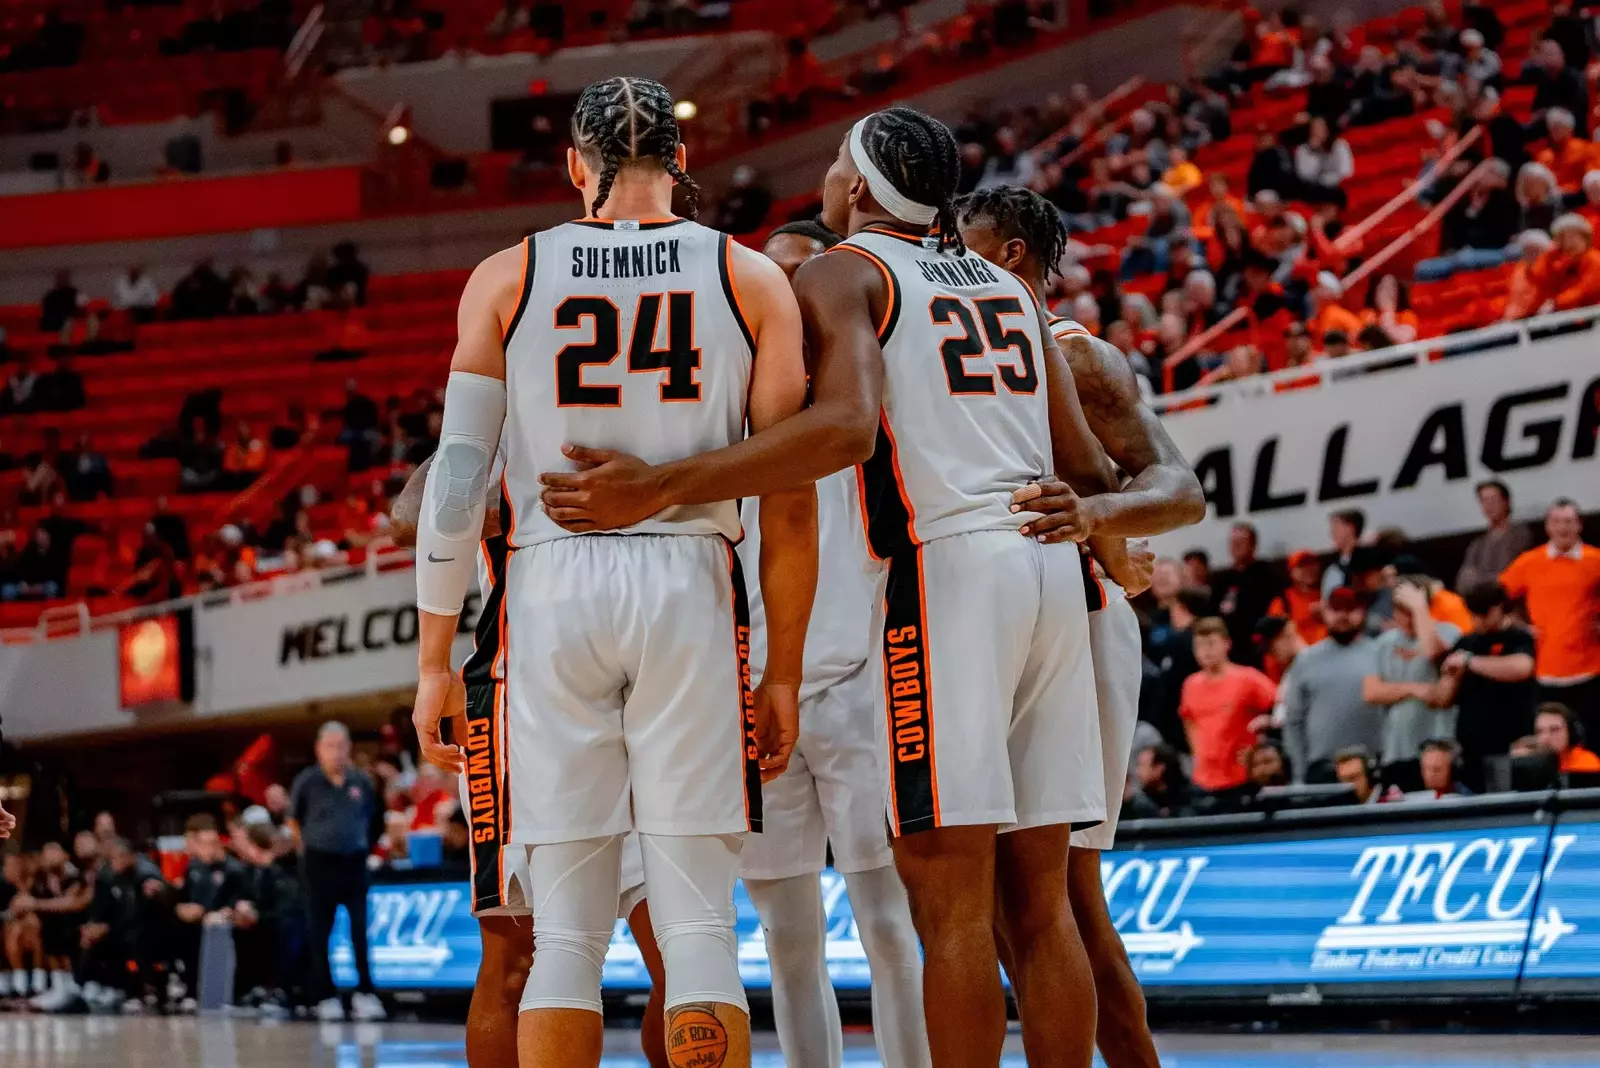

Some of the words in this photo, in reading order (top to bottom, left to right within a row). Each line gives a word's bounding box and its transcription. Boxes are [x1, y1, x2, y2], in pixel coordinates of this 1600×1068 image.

[571, 239, 681, 278] SUEMNICK
[915, 258, 999, 287] JENNINGS
[554, 291, 702, 408] 24
[928, 295, 1039, 396] 25
[278, 592, 481, 666] WELCOE
[887, 625, 925, 762] COWBOYS
[467, 717, 495, 844] COWBOYS
[1335, 834, 1578, 924] TFCU
[689, 1026, 718, 1042] ROCK
